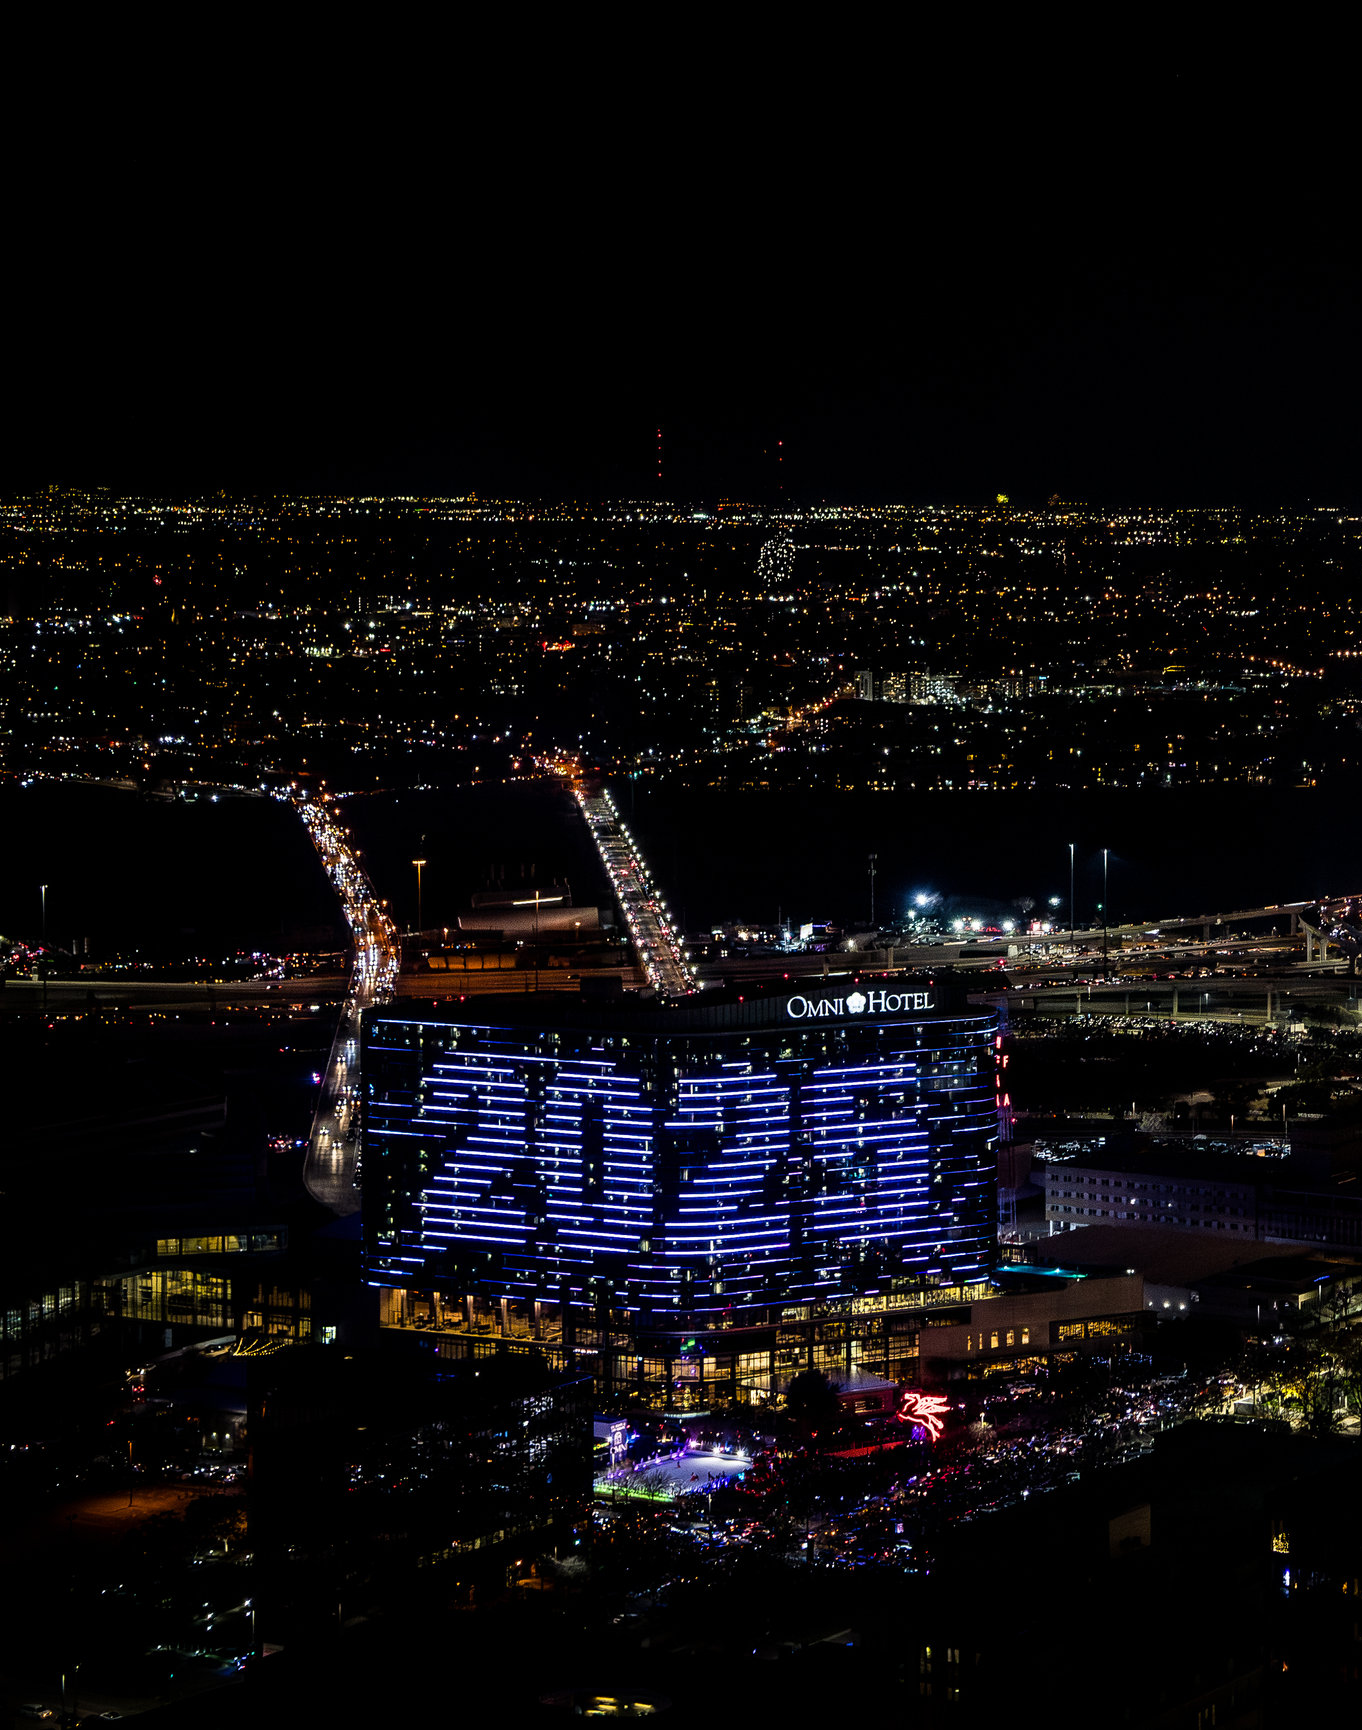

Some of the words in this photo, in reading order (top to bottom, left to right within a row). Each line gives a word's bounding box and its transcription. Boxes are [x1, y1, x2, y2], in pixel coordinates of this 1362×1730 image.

[786, 995, 845, 1019] OMNI
[867, 990, 935, 1014] HOTEL
[413, 1052, 931, 1256] 2025
